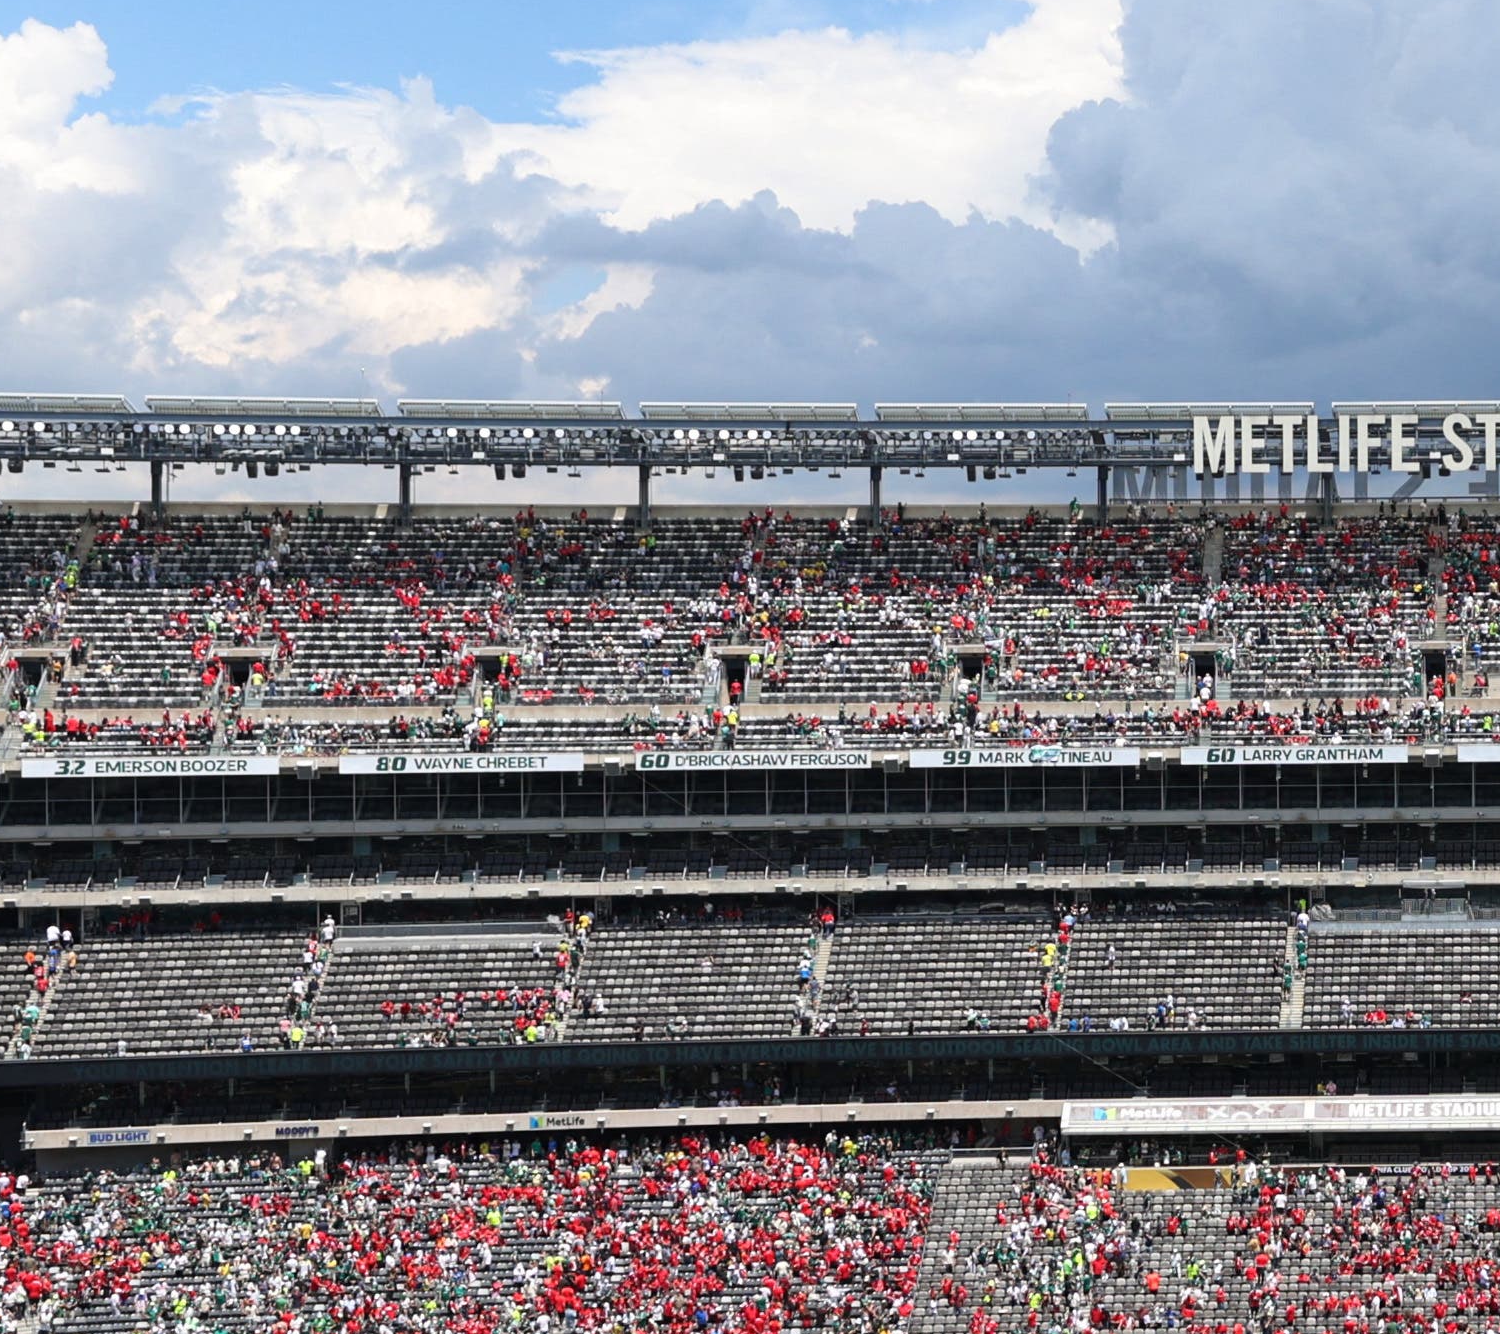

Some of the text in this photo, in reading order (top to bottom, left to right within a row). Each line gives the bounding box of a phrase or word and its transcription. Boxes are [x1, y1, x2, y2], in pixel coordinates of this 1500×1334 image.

[1193, 413, 1421, 474] METLIFE
[641, 753, 867, 768] 60 D'BRICKASHAW FERGUSON
[943, 750, 1112, 765] 99 MARK GTINEAU
[1206, 748, 1383, 763] 60 LARRY GRANTHAM
[55, 759, 247, 774] 32 EMERSON BOOZER
[376, 756, 547, 771] 80 WAYNE CHREBET
[1120, 1107, 1182, 1119] MetLife
[1348, 1102, 1425, 1117] METLIFE
[546, 1116, 584, 1127] MetLife
[90, 1131, 149, 1144] BUD LIGHT
